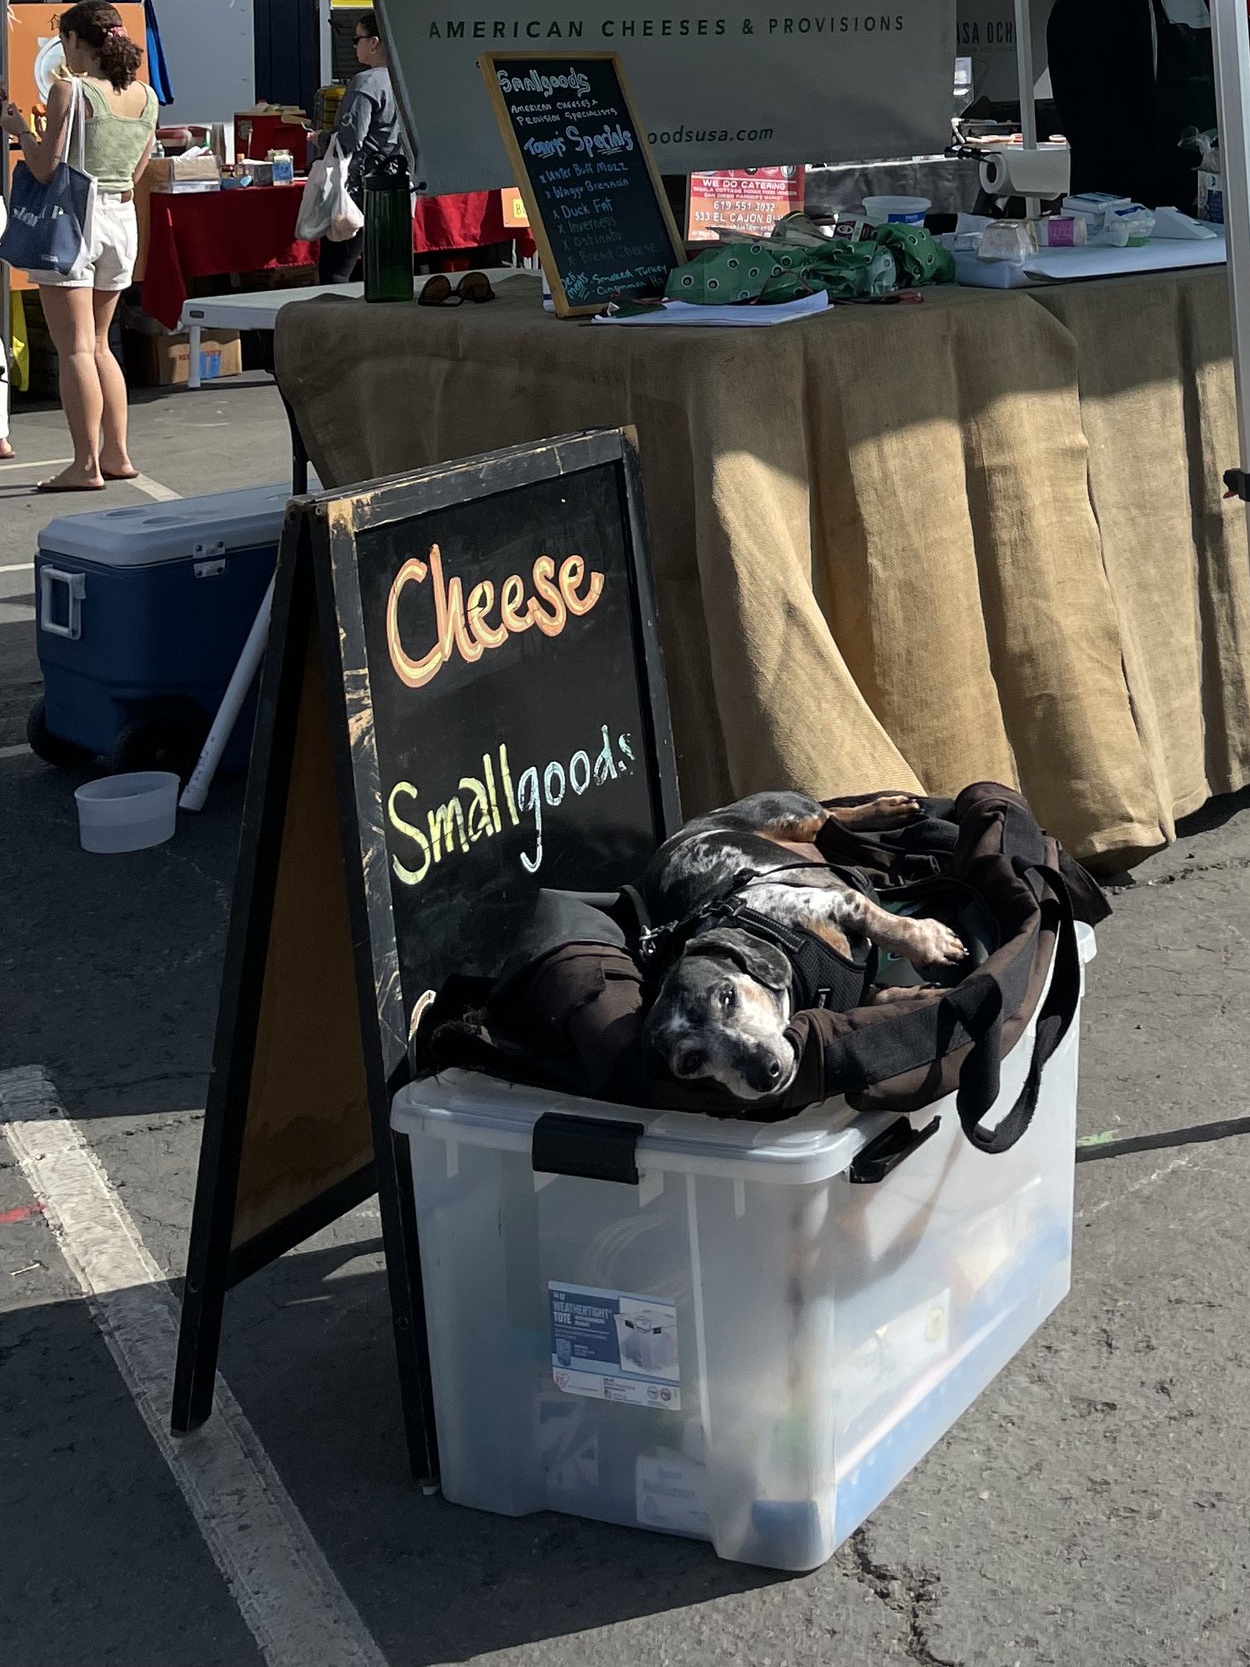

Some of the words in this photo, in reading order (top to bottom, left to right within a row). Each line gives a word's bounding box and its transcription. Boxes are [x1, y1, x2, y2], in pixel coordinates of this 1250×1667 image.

[428, 19, 584, 39] AMERICAN
[601, 18, 727, 38] CHEESES
[742, 18, 754, 35] &
[768, 14, 905, 35] PROVISIONS
[510, 102, 553, 115] AMERICAN
[648, 124, 774, 145] oodsusa.com
[702, 178, 720, 188] WE
[722, 180, 738, 188] DO
[741, 181, 787, 191] CATERING
[713, 212, 726, 222] EL
[729, 213, 763, 224] CAJON
[386, 542, 606, 689] Cheese
[388, 724, 635, 886] Smallgoods
